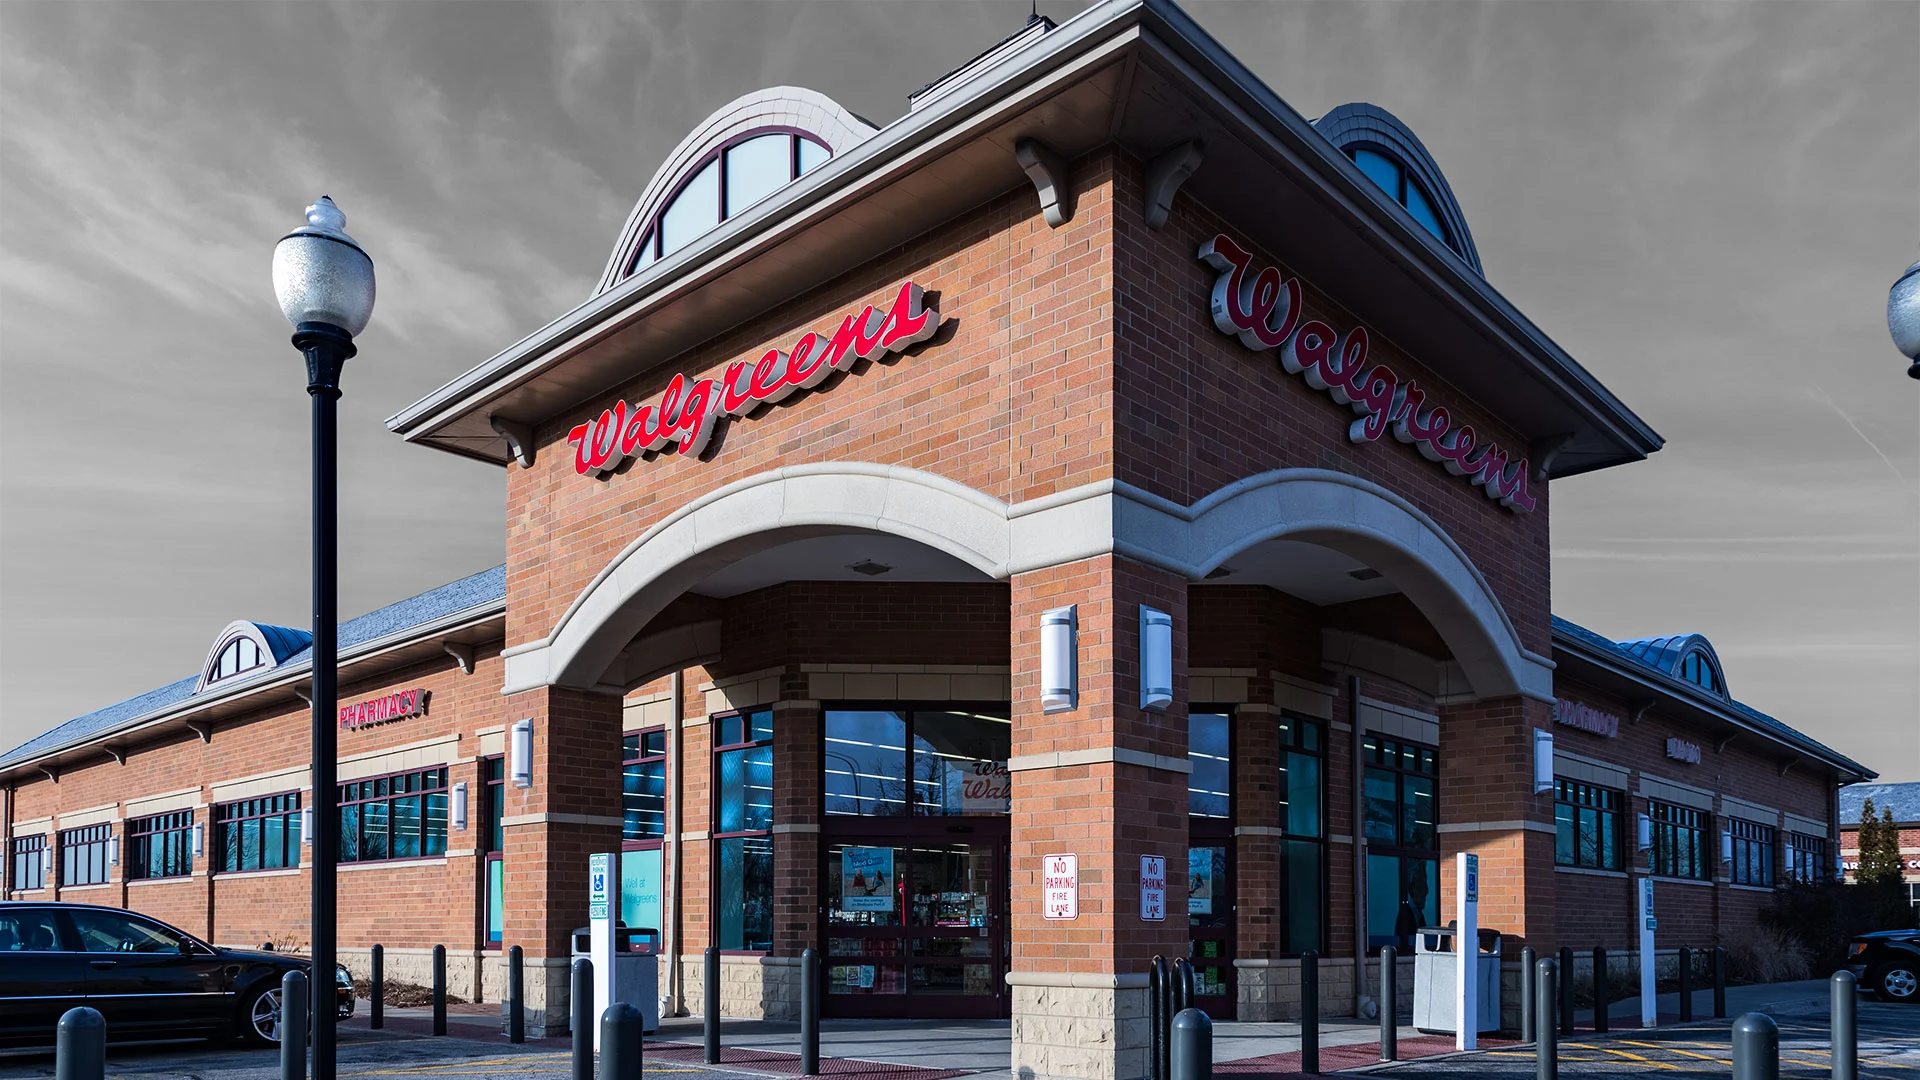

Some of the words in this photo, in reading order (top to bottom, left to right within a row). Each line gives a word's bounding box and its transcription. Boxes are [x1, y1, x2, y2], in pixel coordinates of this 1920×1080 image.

[568, 280, 933, 478] Walgreens
[1199, 233, 1536, 513] Walgreens
[340, 688, 419, 729] PHARMACY
[1557, 697, 1619, 738] PHARMACY
[1053, 861, 1067, 874] NO
[1148, 862, 1158, 876] NO
[624, 877, 638, 888] Well
[639, 878, 646, 888] at
[1045, 876, 1075, 889] PARKING
[1142, 878, 1164, 891] PARKING
[624, 892, 657, 906] Walgreens
[1052, 892, 1068, 901] FIRE
[1146, 893, 1159, 903] FIRE
[1051, 903, 1070, 912] LANE
[1146, 904, 1160, 914] LANE
